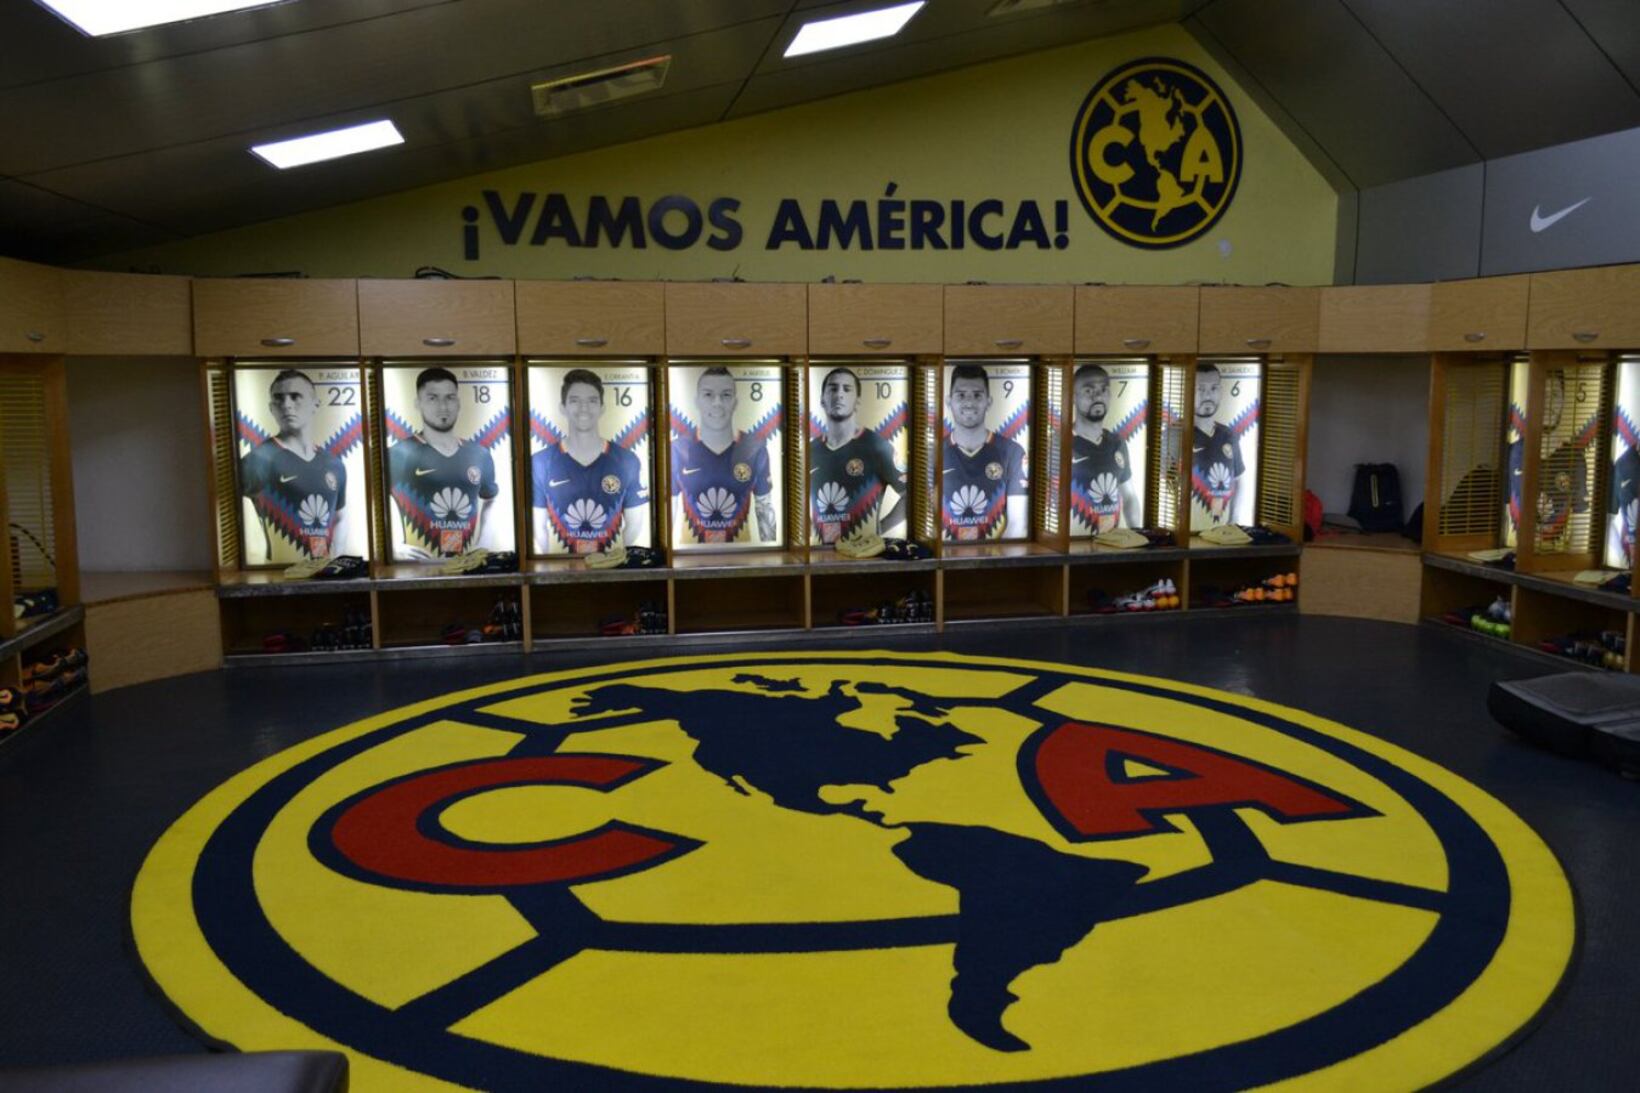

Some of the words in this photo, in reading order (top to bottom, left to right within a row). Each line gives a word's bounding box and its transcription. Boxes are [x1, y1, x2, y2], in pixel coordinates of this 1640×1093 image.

[1088, 125, 1135, 185] C
[1180, 126, 1225, 183] A
[461, 190, 743, 260] ¡VAMOS
[765, 181, 1070, 250] AMÉRICA!
[328, 386, 356, 406] 22
[472, 385, 491, 403] 18
[614, 386, 632, 407] 16
[750, 382, 763, 402] 8
[875, 381, 891, 399] 10
[1003, 380, 1014, 399] 9
[1117, 380, 1128, 398] 7
[1230, 380, 1240, 397] 6
[1576, 382, 1587, 403] 5
[430, 520, 471, 529] HUAWEI
[309, 752, 706, 896] C
[1017, 718, 1384, 844] A
